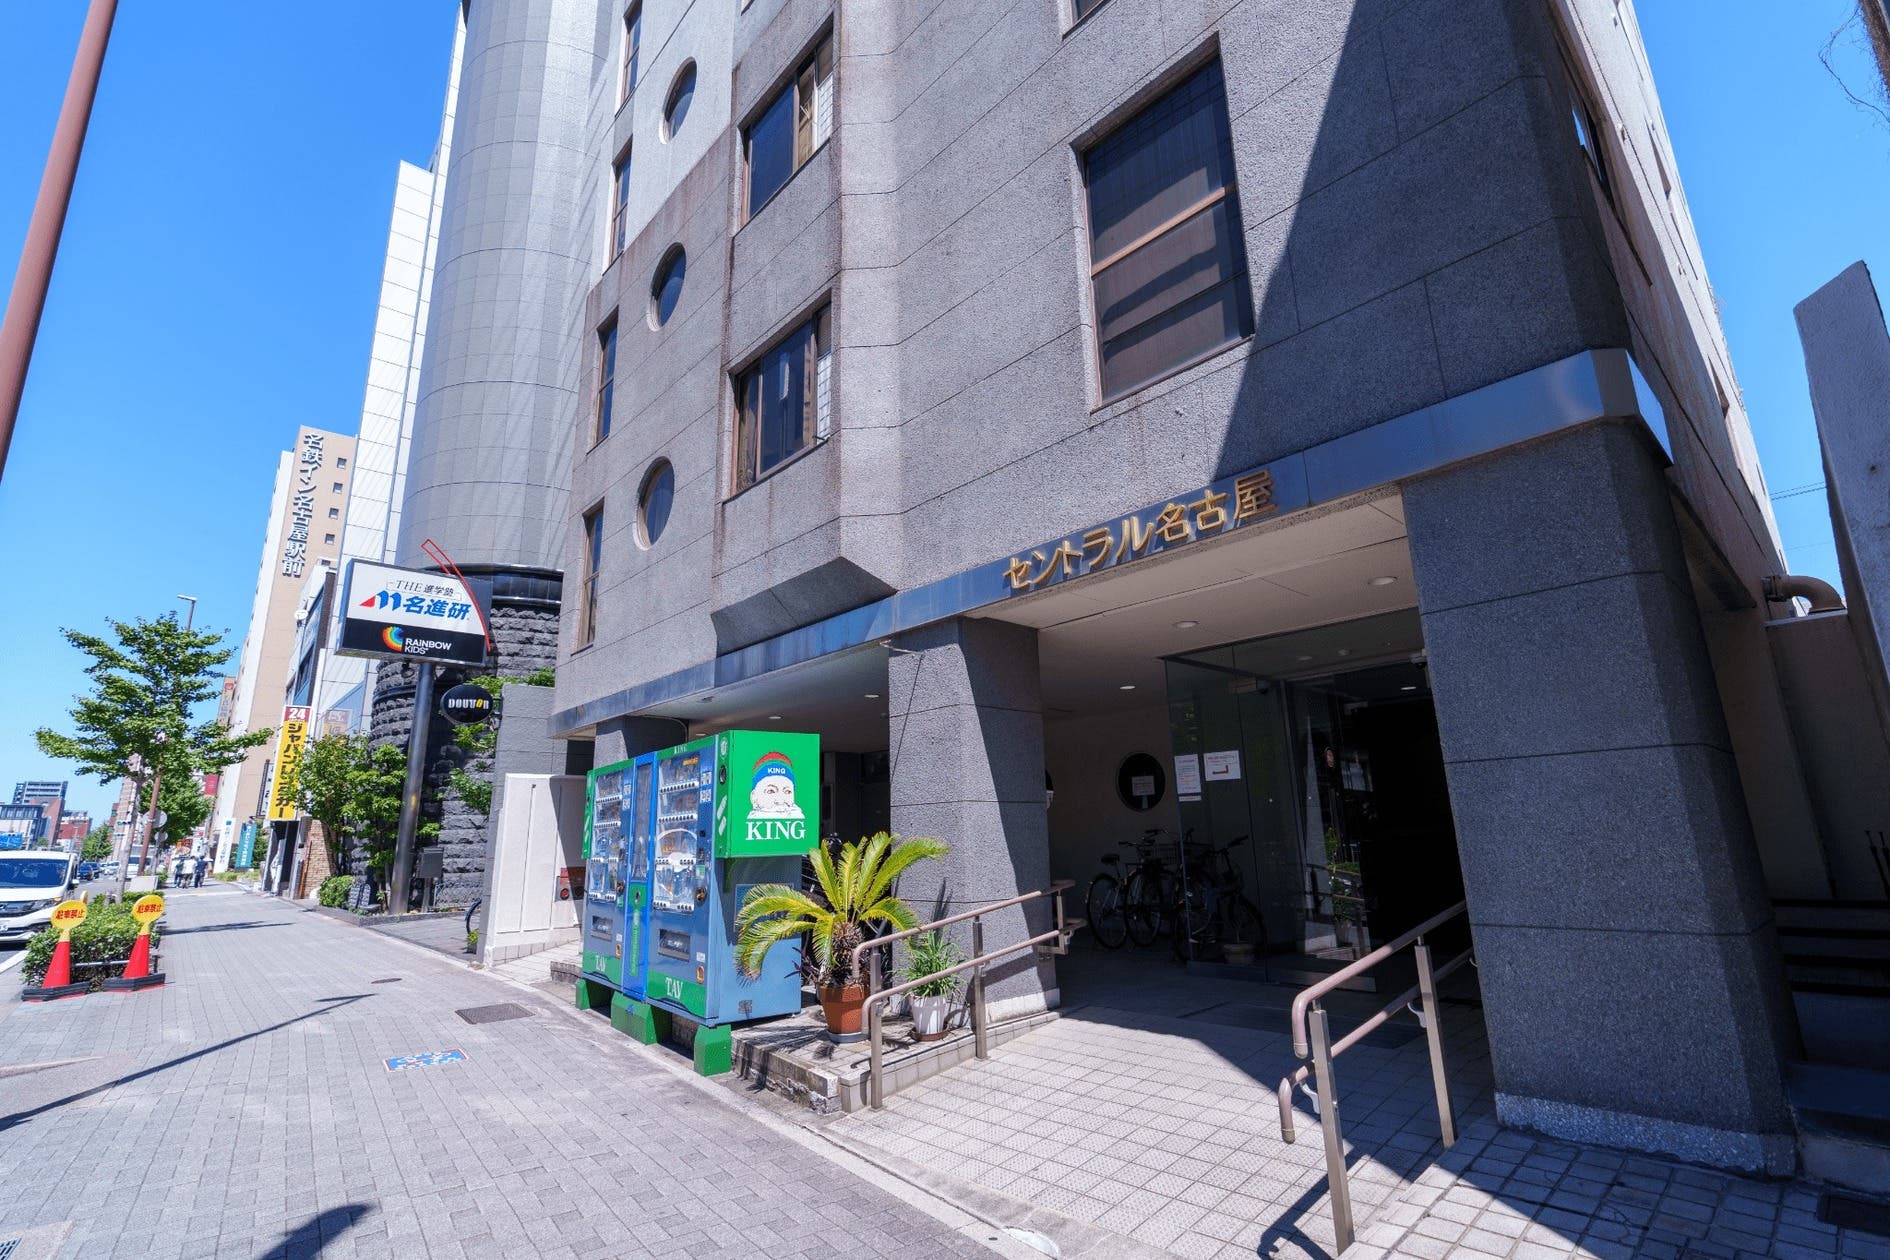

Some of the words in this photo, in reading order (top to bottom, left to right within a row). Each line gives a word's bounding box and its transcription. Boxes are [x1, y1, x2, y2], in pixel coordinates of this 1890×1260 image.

[282, 433, 324, 578] 名鉄イン名古屋駅前
[1003, 468, 1277, 589] セントラル名古屋
[396, 580, 423, 593] THE
[403, 596, 471, 620] 名進研
[288, 708, 306, 719] 24
[448, 698, 489, 709] DOUTOR
[745, 820, 807, 841] KING
